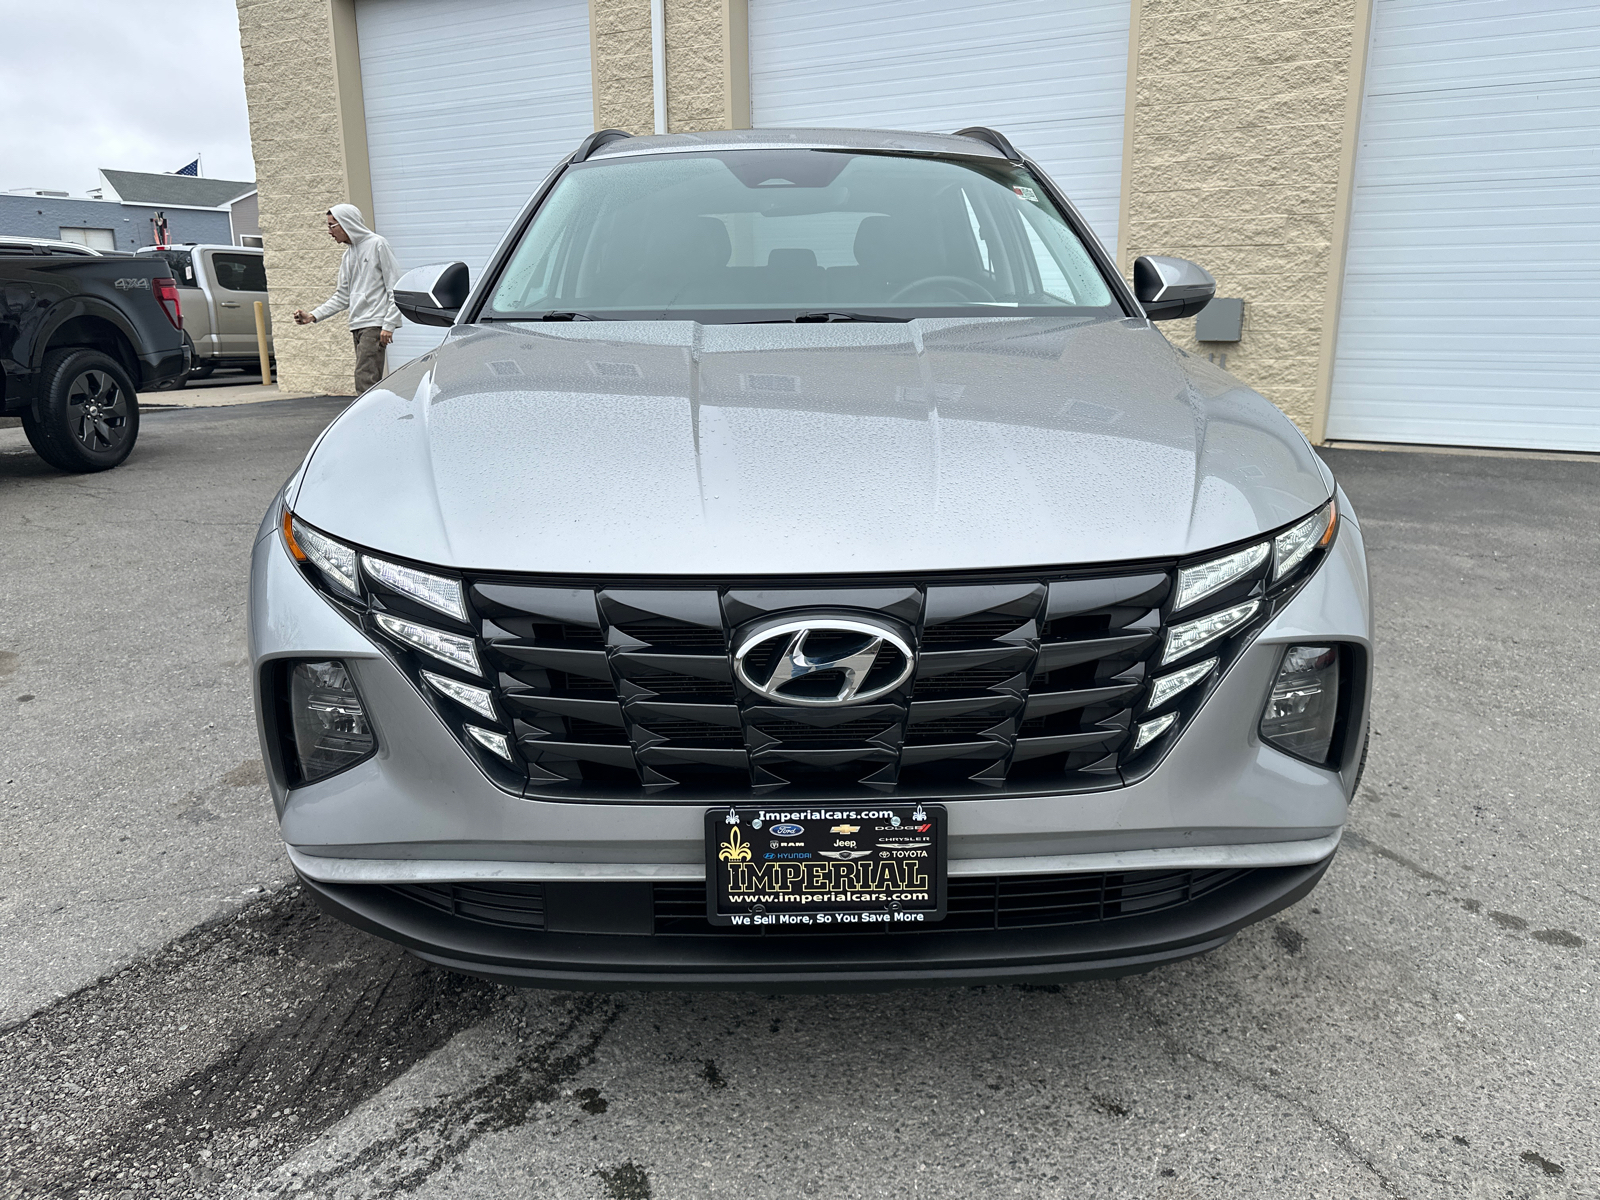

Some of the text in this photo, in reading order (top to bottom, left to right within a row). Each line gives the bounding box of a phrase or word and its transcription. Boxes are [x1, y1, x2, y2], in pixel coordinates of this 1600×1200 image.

[758, 809, 894, 822] Imperialcars.com
[776, 825, 797, 834] Ford
[833, 839, 857, 848] Jeep
[892, 850, 928, 858] TOYOTA
[728, 860, 928, 892] IMPERIAL
[728, 892, 929, 904] www.imperialcars.com
[731, 912, 924, 925] We Sell More, So You Save More
